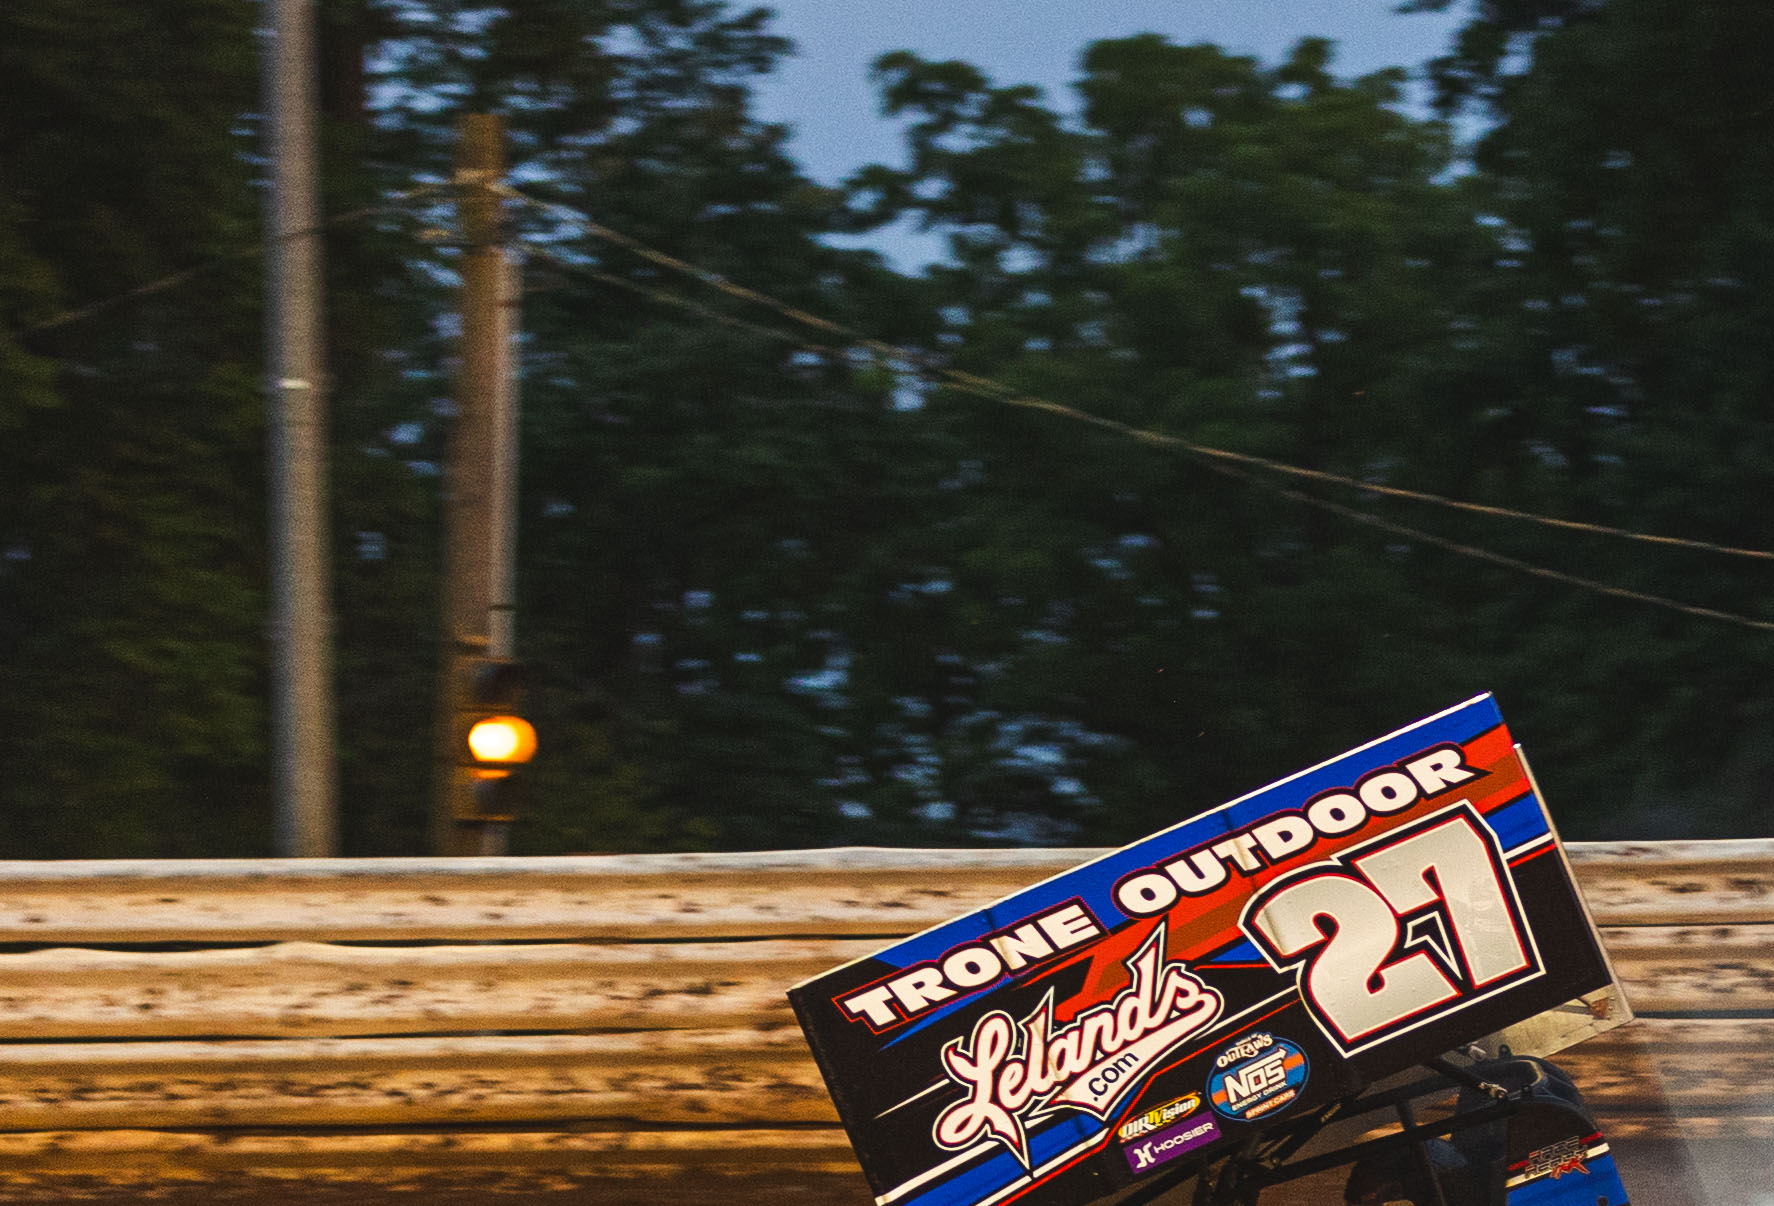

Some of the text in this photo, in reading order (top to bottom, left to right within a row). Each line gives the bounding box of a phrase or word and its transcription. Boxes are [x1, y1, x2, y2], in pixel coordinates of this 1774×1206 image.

[844, 749, 1476, 1028] TRONE OUTDOOR
[1250, 813, 1531, 1044] 27
[935, 940, 1220, 1150] Lelands
[1087, 1050, 1140, 1102] .com
[1223, 1047, 1287, 1105] NOS
[1231, 1080, 1288, 1112] ENERGY DRINK
[1153, 1121, 1215, 1153] HOOSIER
